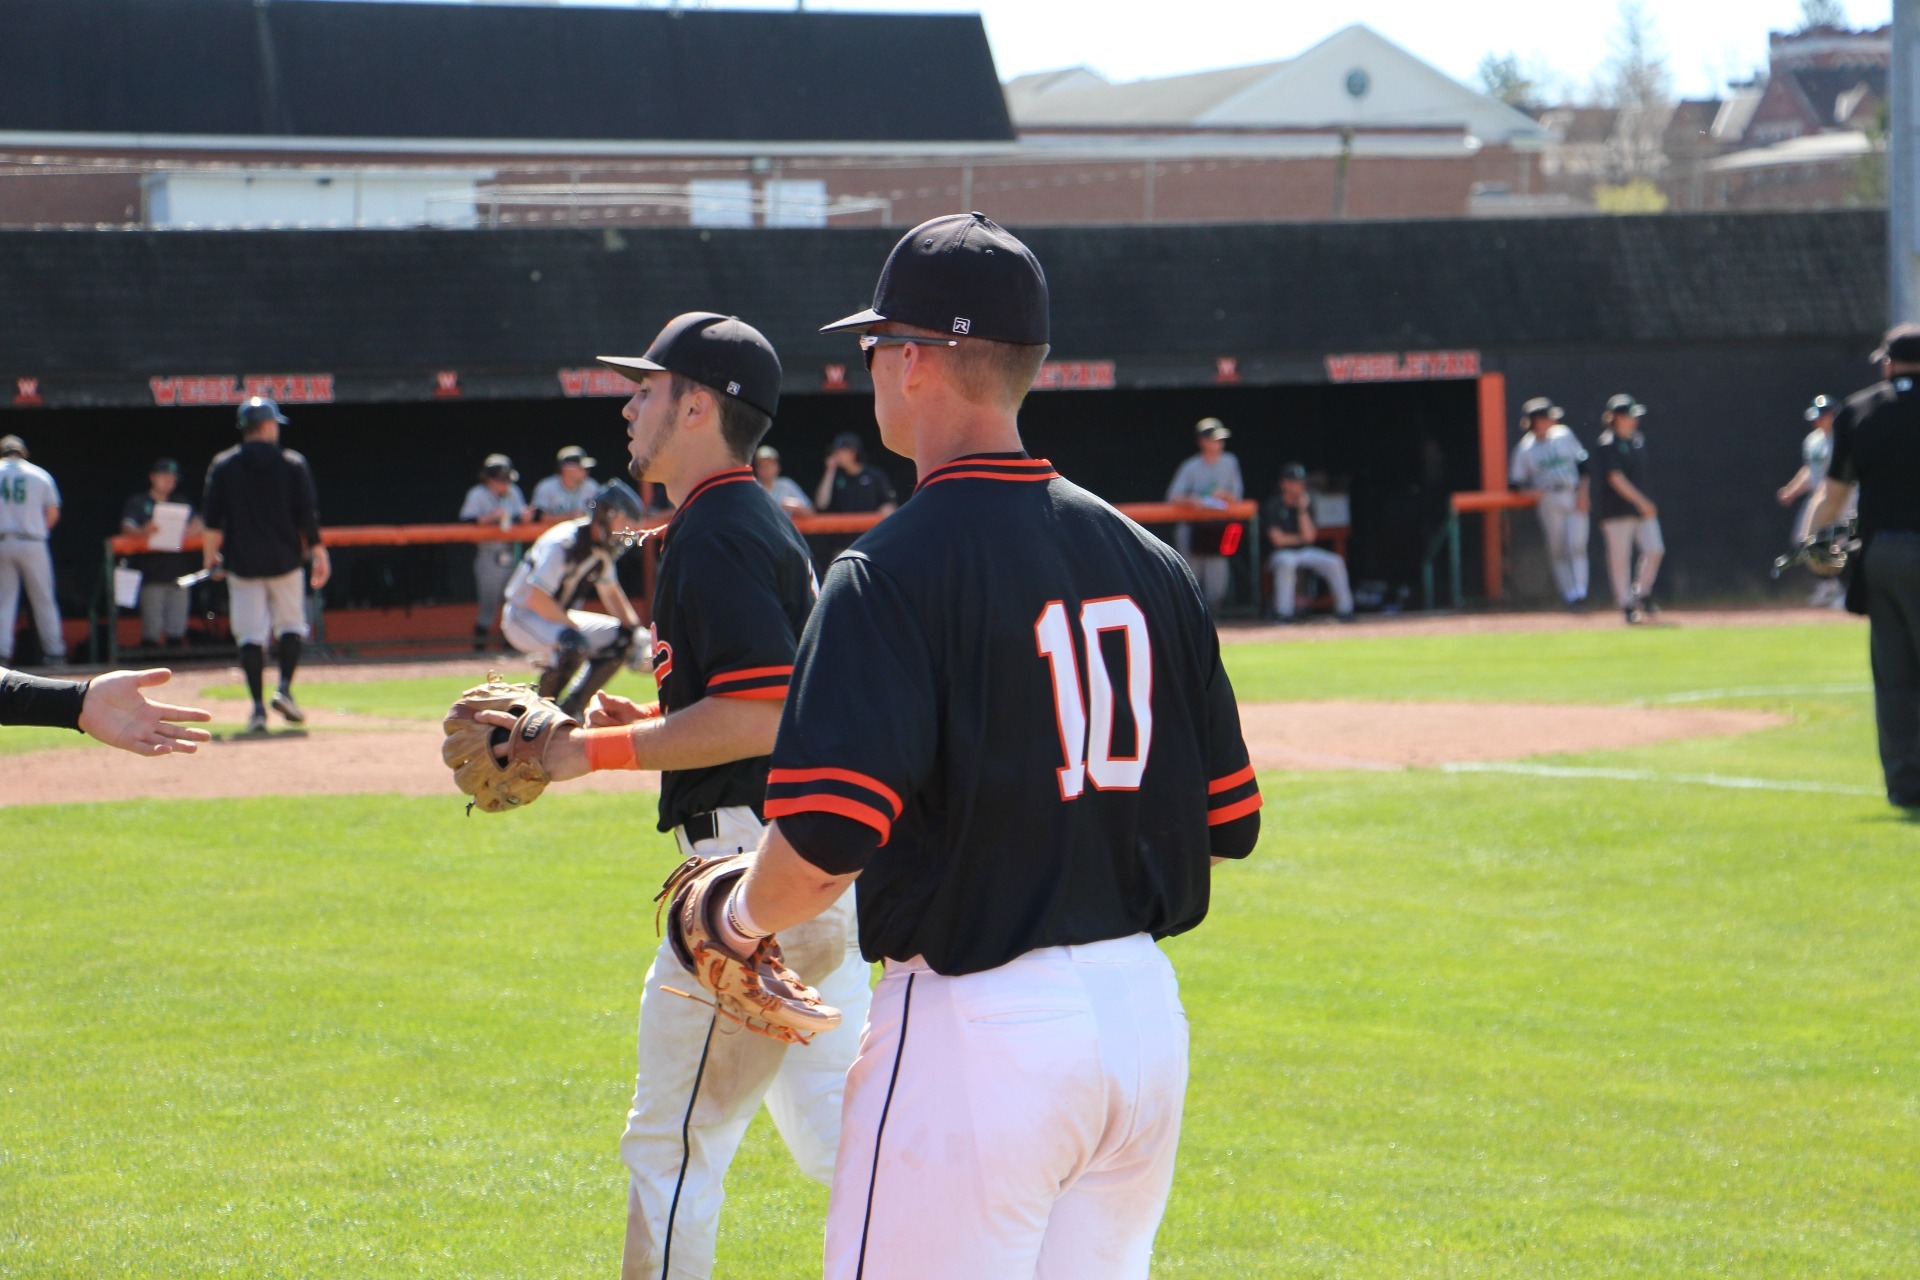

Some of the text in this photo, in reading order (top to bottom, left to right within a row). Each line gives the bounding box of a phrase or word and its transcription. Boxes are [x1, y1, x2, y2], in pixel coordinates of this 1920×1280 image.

[437, 370, 458, 389] W
[825, 364, 846, 383] W
[1326, 351, 1480, 384] WESLEYAN
[17, 377, 38, 397] W
[150, 374, 334, 406] WESLEYAN
[0, 476, 26, 504] 46
[1034, 595, 1153, 801] 10
